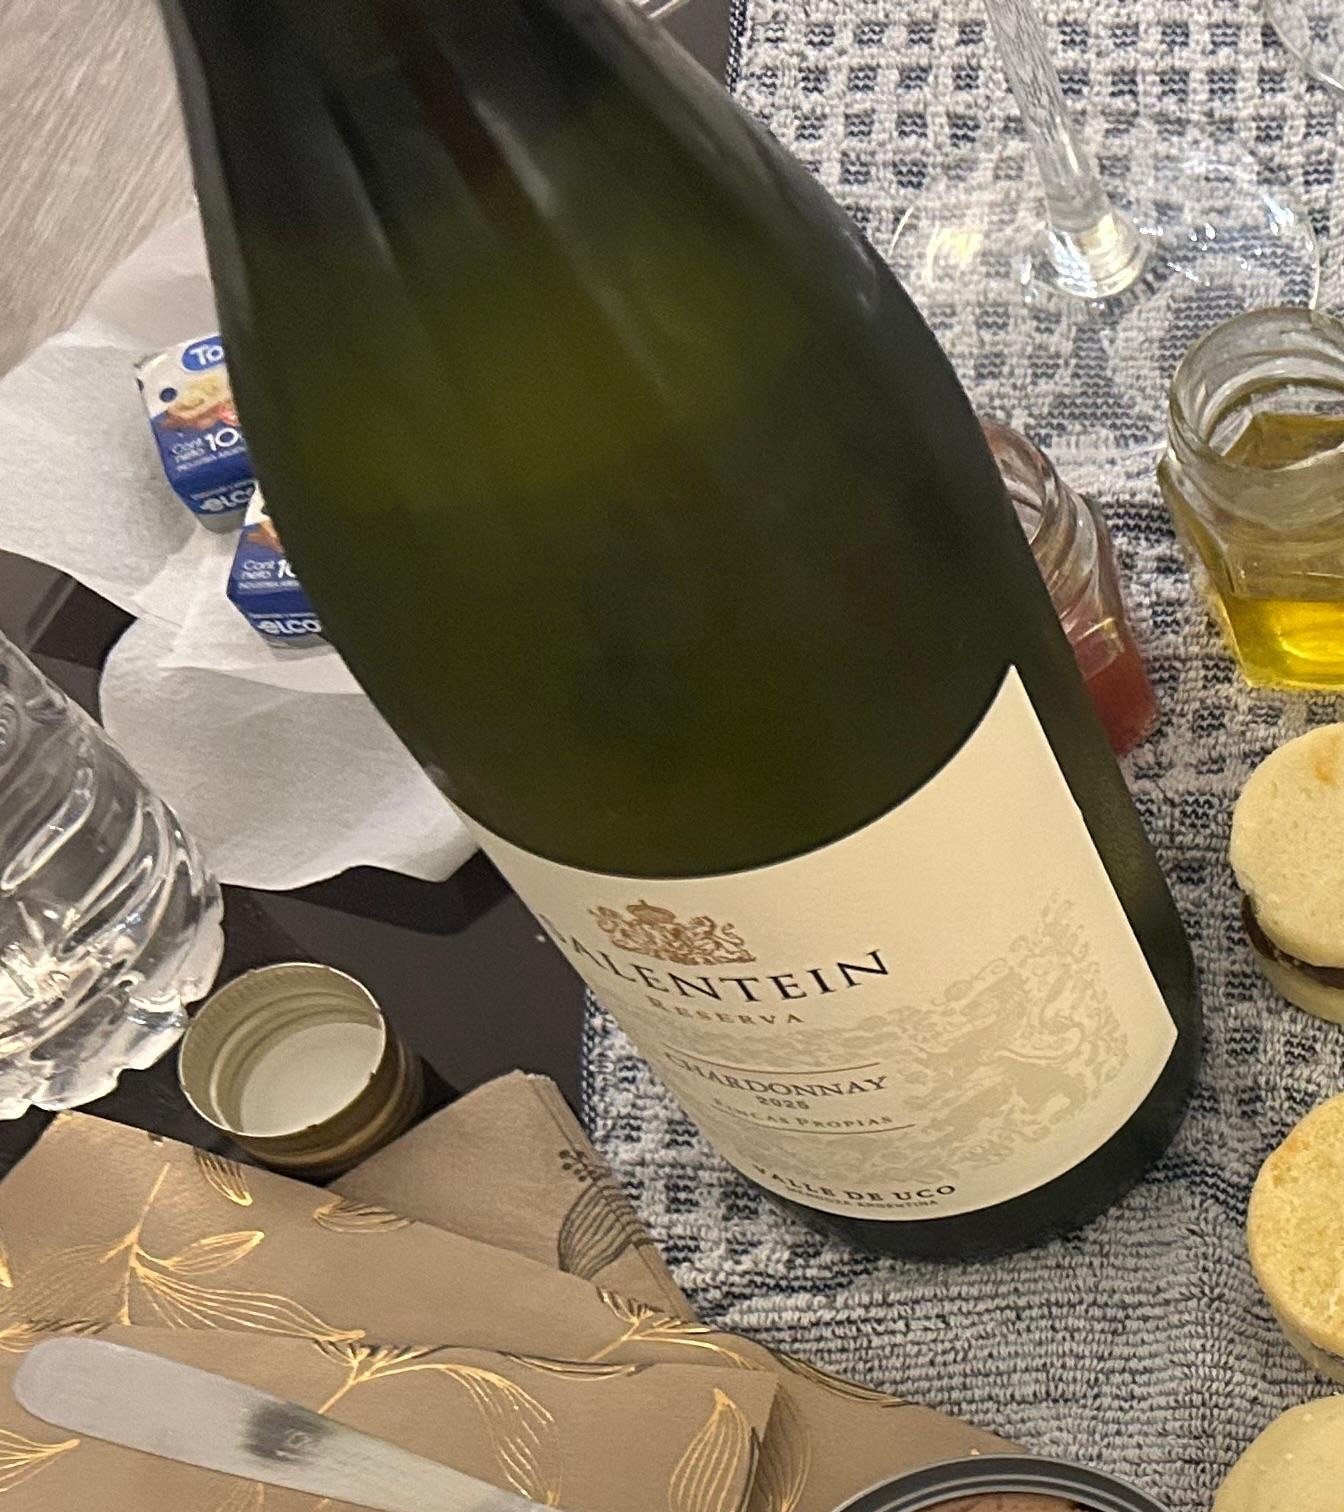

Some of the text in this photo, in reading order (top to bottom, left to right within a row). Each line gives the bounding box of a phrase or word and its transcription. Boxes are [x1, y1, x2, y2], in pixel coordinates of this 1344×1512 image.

[204, 427, 245, 451] 10
[645, 995, 805, 1025] RESERVA
[663, 1051, 888, 1097] CHARDONNAY
[796, 1114, 894, 1129] PROPIAS
[843, 1189, 885, 1202] DE
[893, 1184, 957, 1202] UCO
